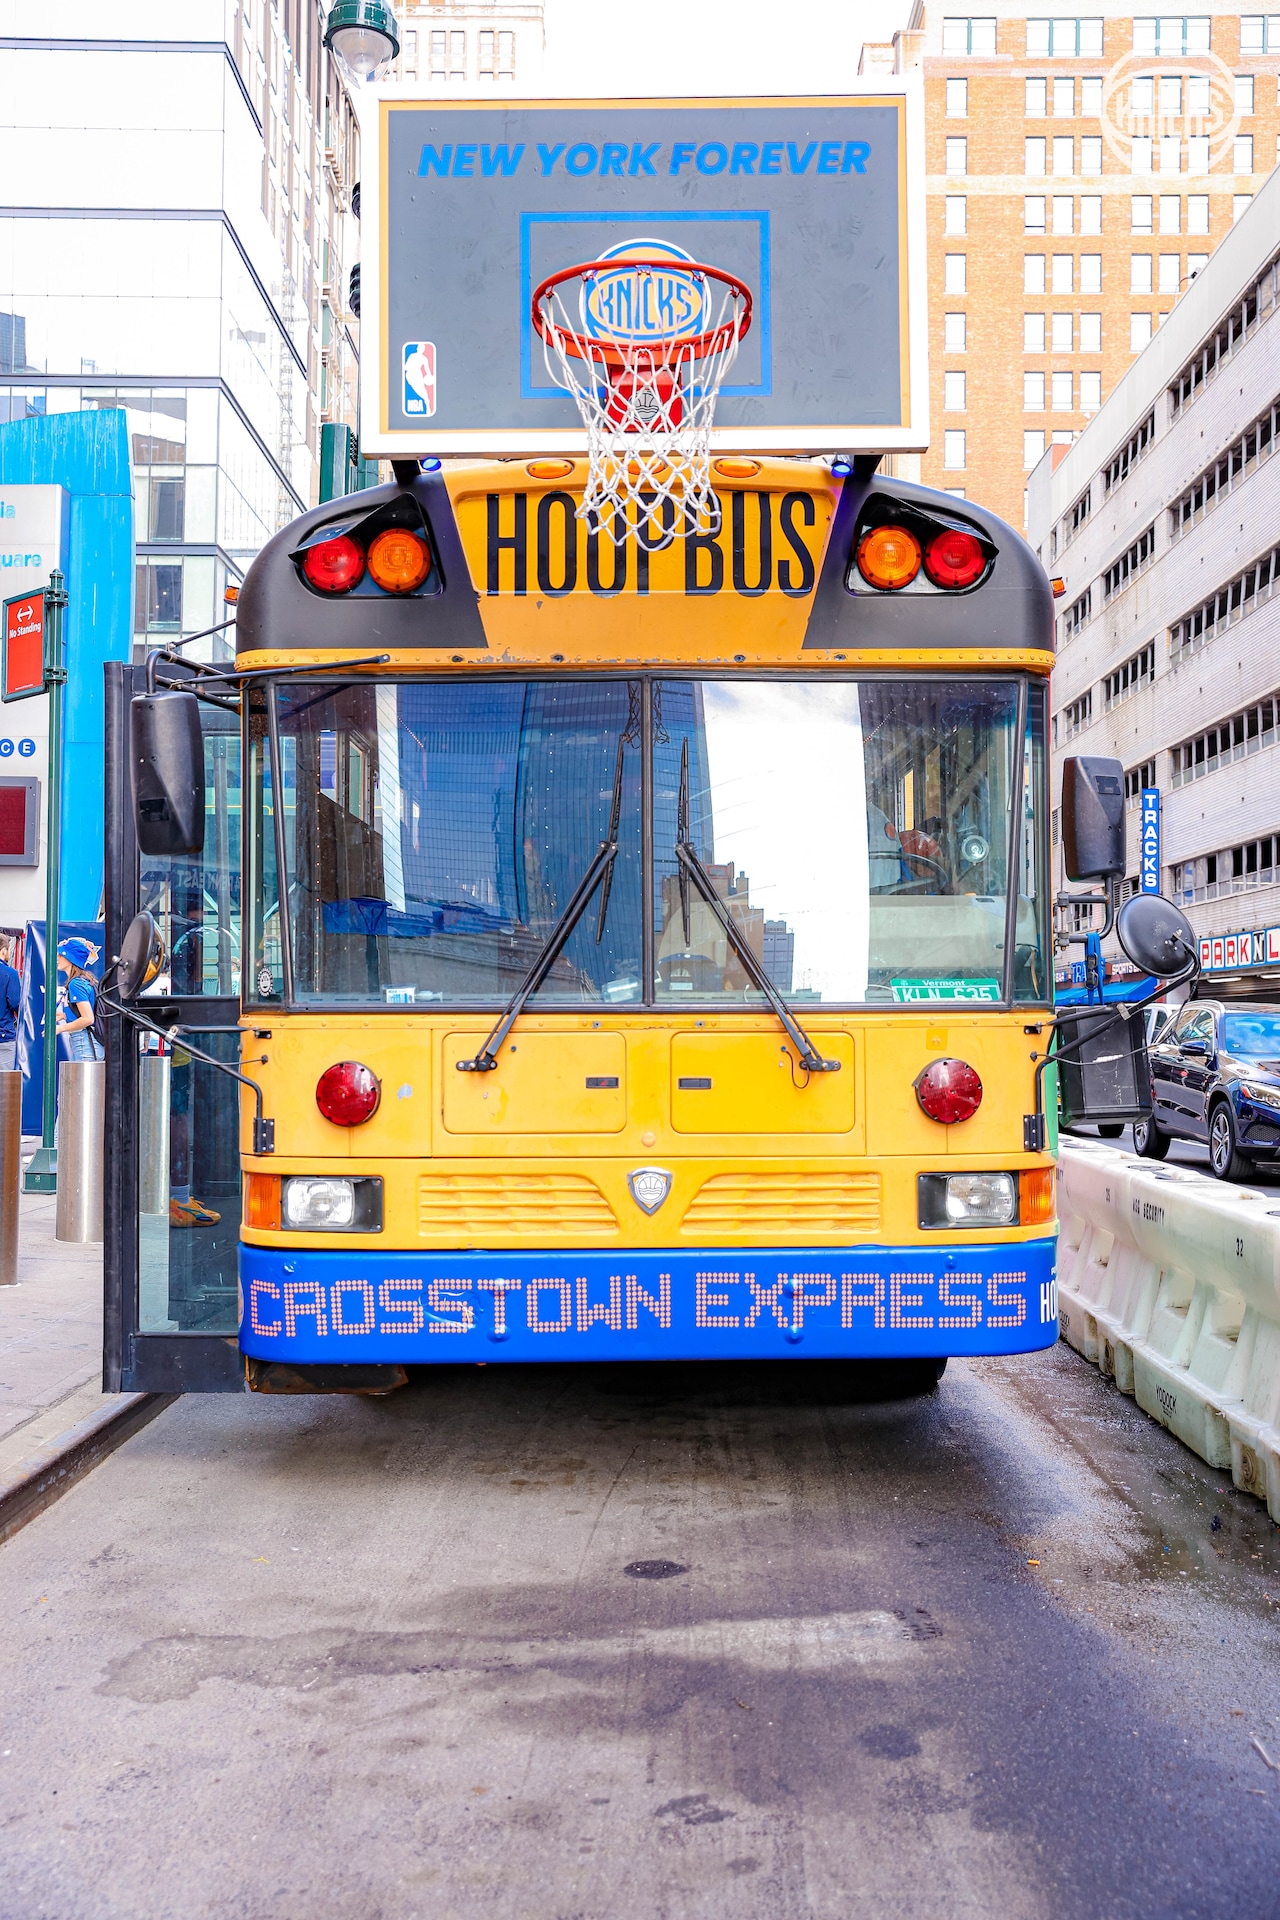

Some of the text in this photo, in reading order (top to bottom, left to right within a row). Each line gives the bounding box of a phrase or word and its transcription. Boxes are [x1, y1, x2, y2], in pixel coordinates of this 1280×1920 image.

[417, 140, 872, 178] NEW YORK FOREVER
[597, 276, 693, 331] KNICKS
[407, 399, 425, 412] NBA
[486, 490, 816, 598] HOOP BUS
[9, 622, 42, 639] No Standing
[1143, 794, 1158, 888] TRACKS
[1201, 938, 1250, 967] PARK
[921, 979, 966, 987] Vermont
[1111, 962, 1133, 976] SPORTS
[1143, 1202, 1166, 1225] SECURITY
[1235, 1237, 1244, 1258] 32
[249, 1271, 1028, 1338] CROSSTOWN EXPRESS
[1155, 1384, 1177, 1415] YODOCK
